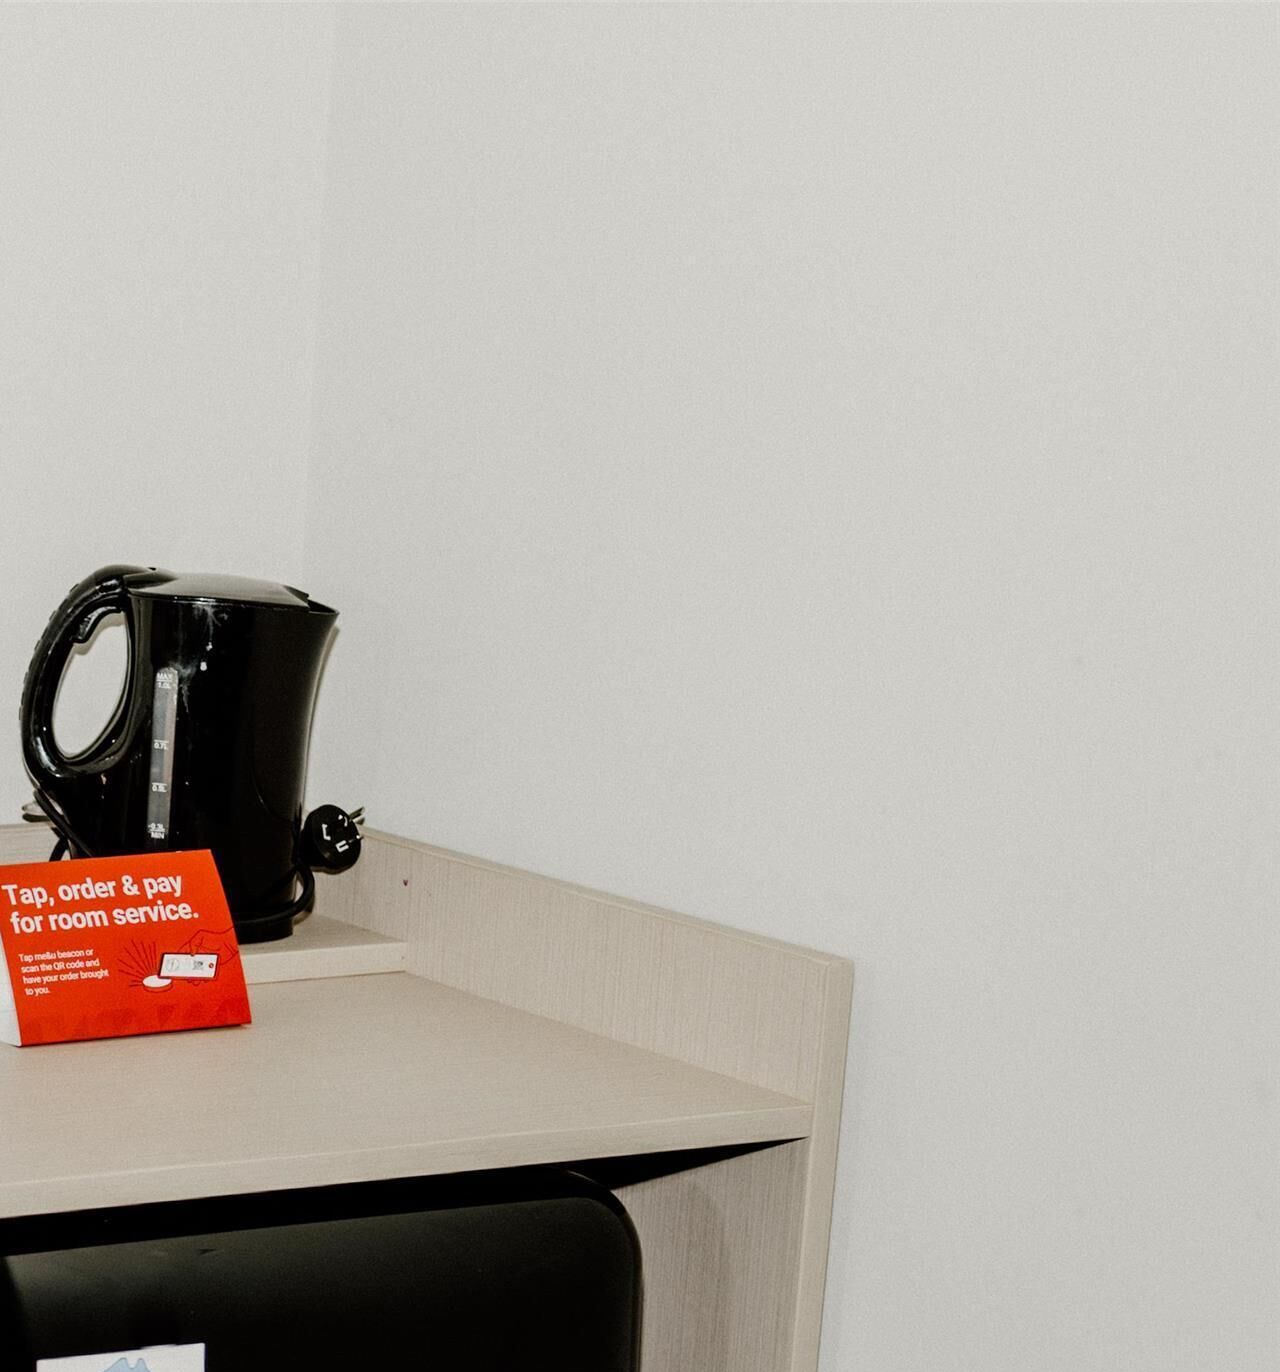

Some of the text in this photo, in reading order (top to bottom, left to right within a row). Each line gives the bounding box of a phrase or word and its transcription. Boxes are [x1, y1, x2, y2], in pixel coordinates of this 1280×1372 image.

[1, 874, 183, 909] Tap, order & pay
[10, 899, 200, 934] for room service.
[18, 953, 34, 963] Tap
[56, 949, 85, 959] beacon
[85, 948, 94, 956] or
[21, 957, 100, 974] scan the QR code and
[22, 968, 110, 984] have your order brought
[24, 987, 34, 996] to
